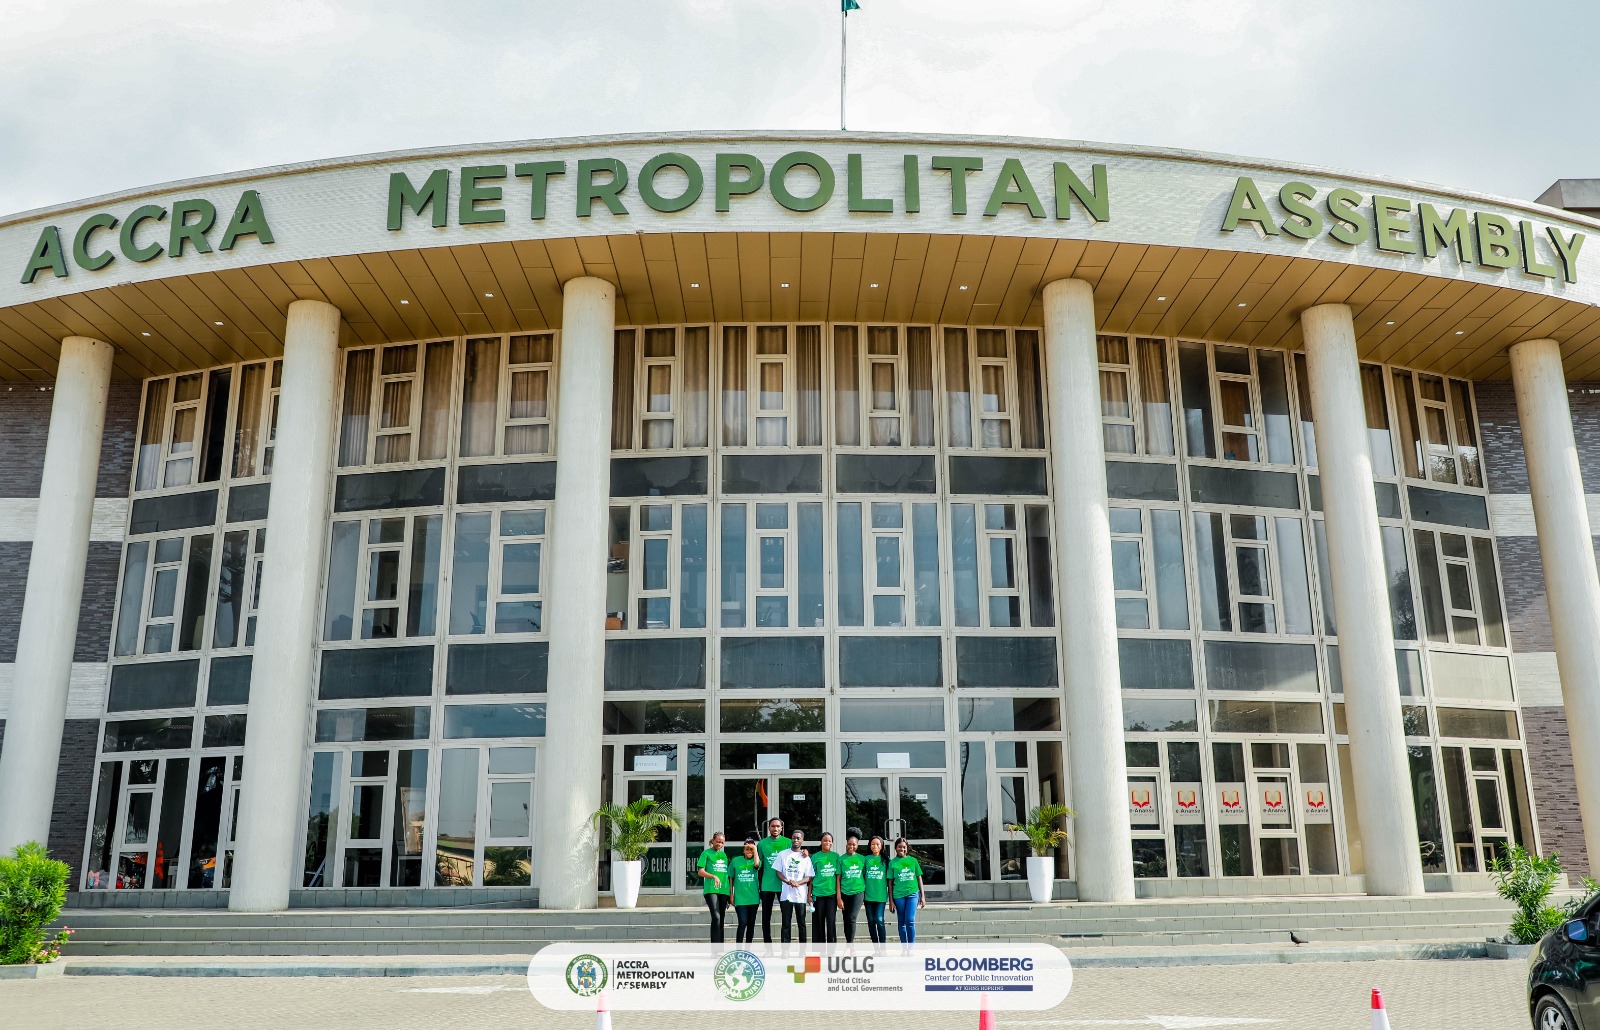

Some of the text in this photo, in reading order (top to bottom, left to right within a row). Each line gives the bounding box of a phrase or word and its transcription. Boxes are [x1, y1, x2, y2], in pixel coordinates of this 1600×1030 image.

[20, 151, 1587, 284] ACCRA METROPOLITAN ASSEMBLY
[651, 857, 672, 873] CLIEN
